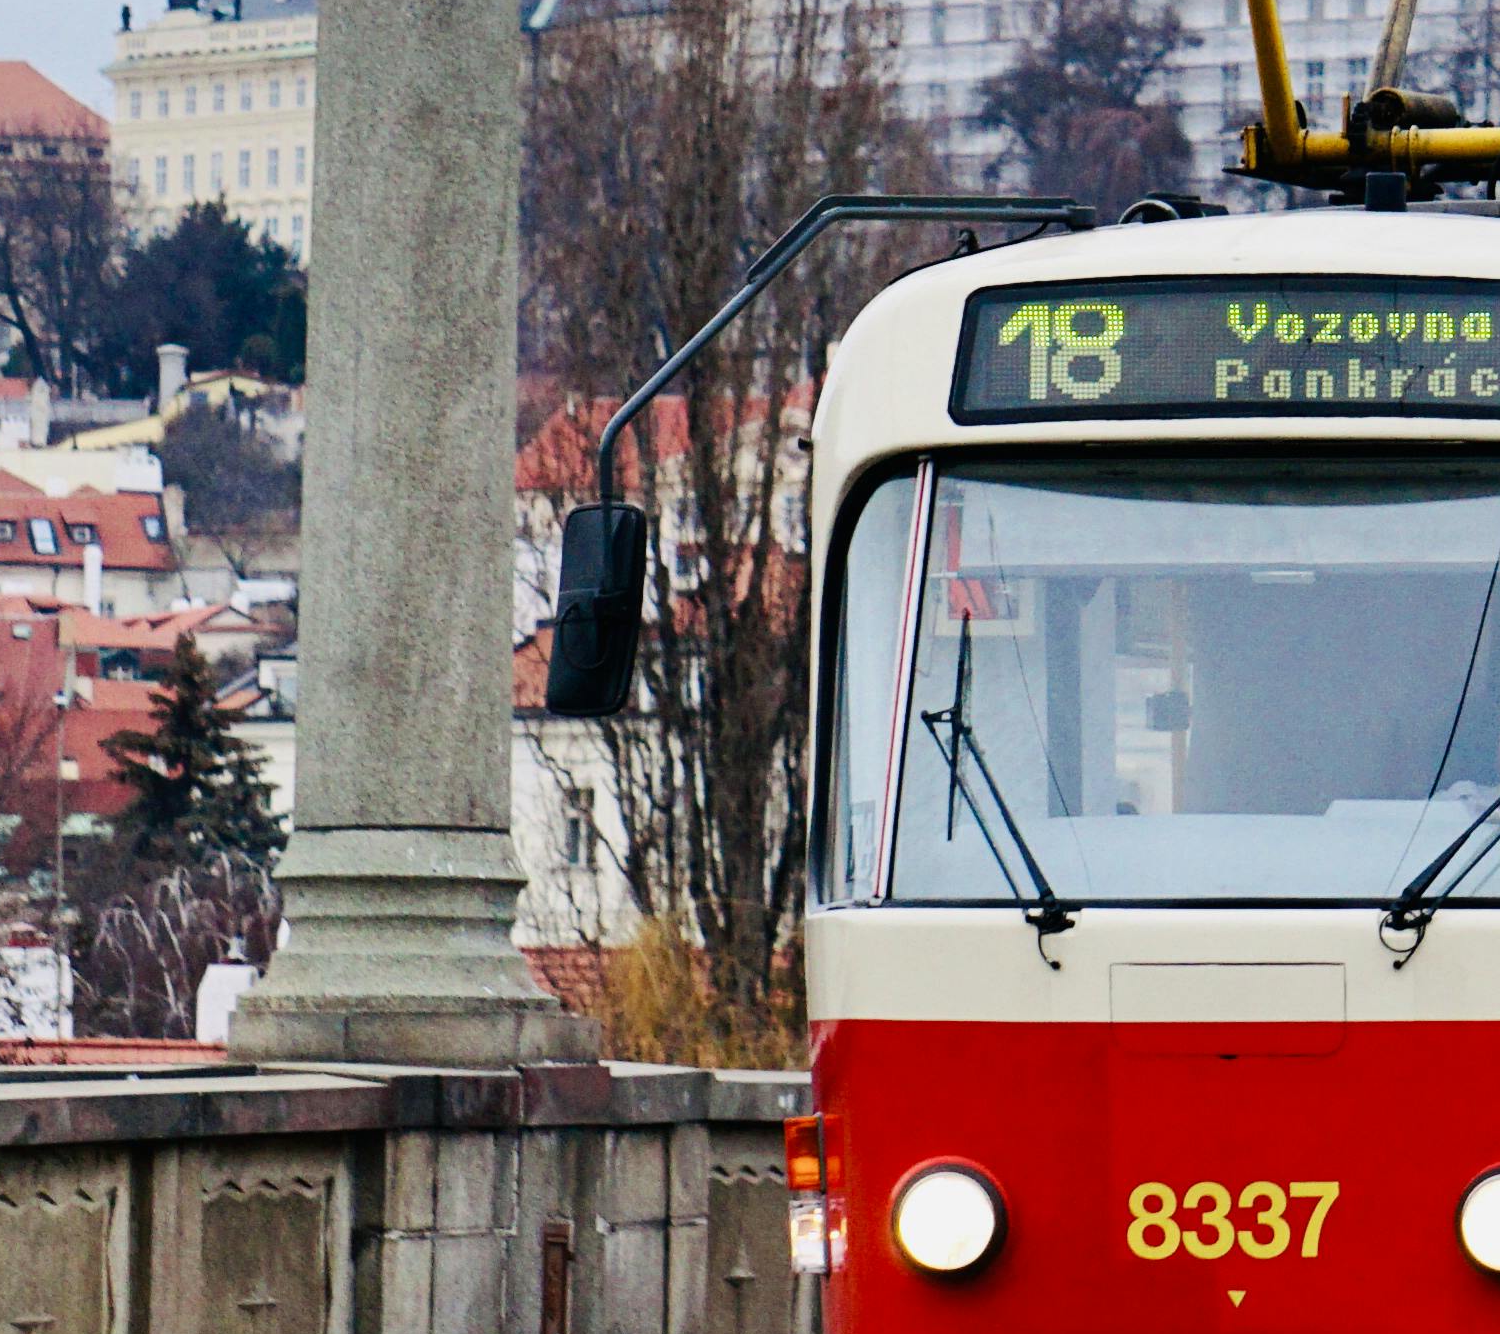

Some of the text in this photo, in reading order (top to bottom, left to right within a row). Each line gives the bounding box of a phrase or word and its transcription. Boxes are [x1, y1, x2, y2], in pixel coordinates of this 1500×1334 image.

[999, 304, 1124, 400] 18
[1227, 302, 1493, 344] Vozovna
[1215, 352, 1500, 398] Pankrác
[1126, 1181, 1340, 1260] 8337
